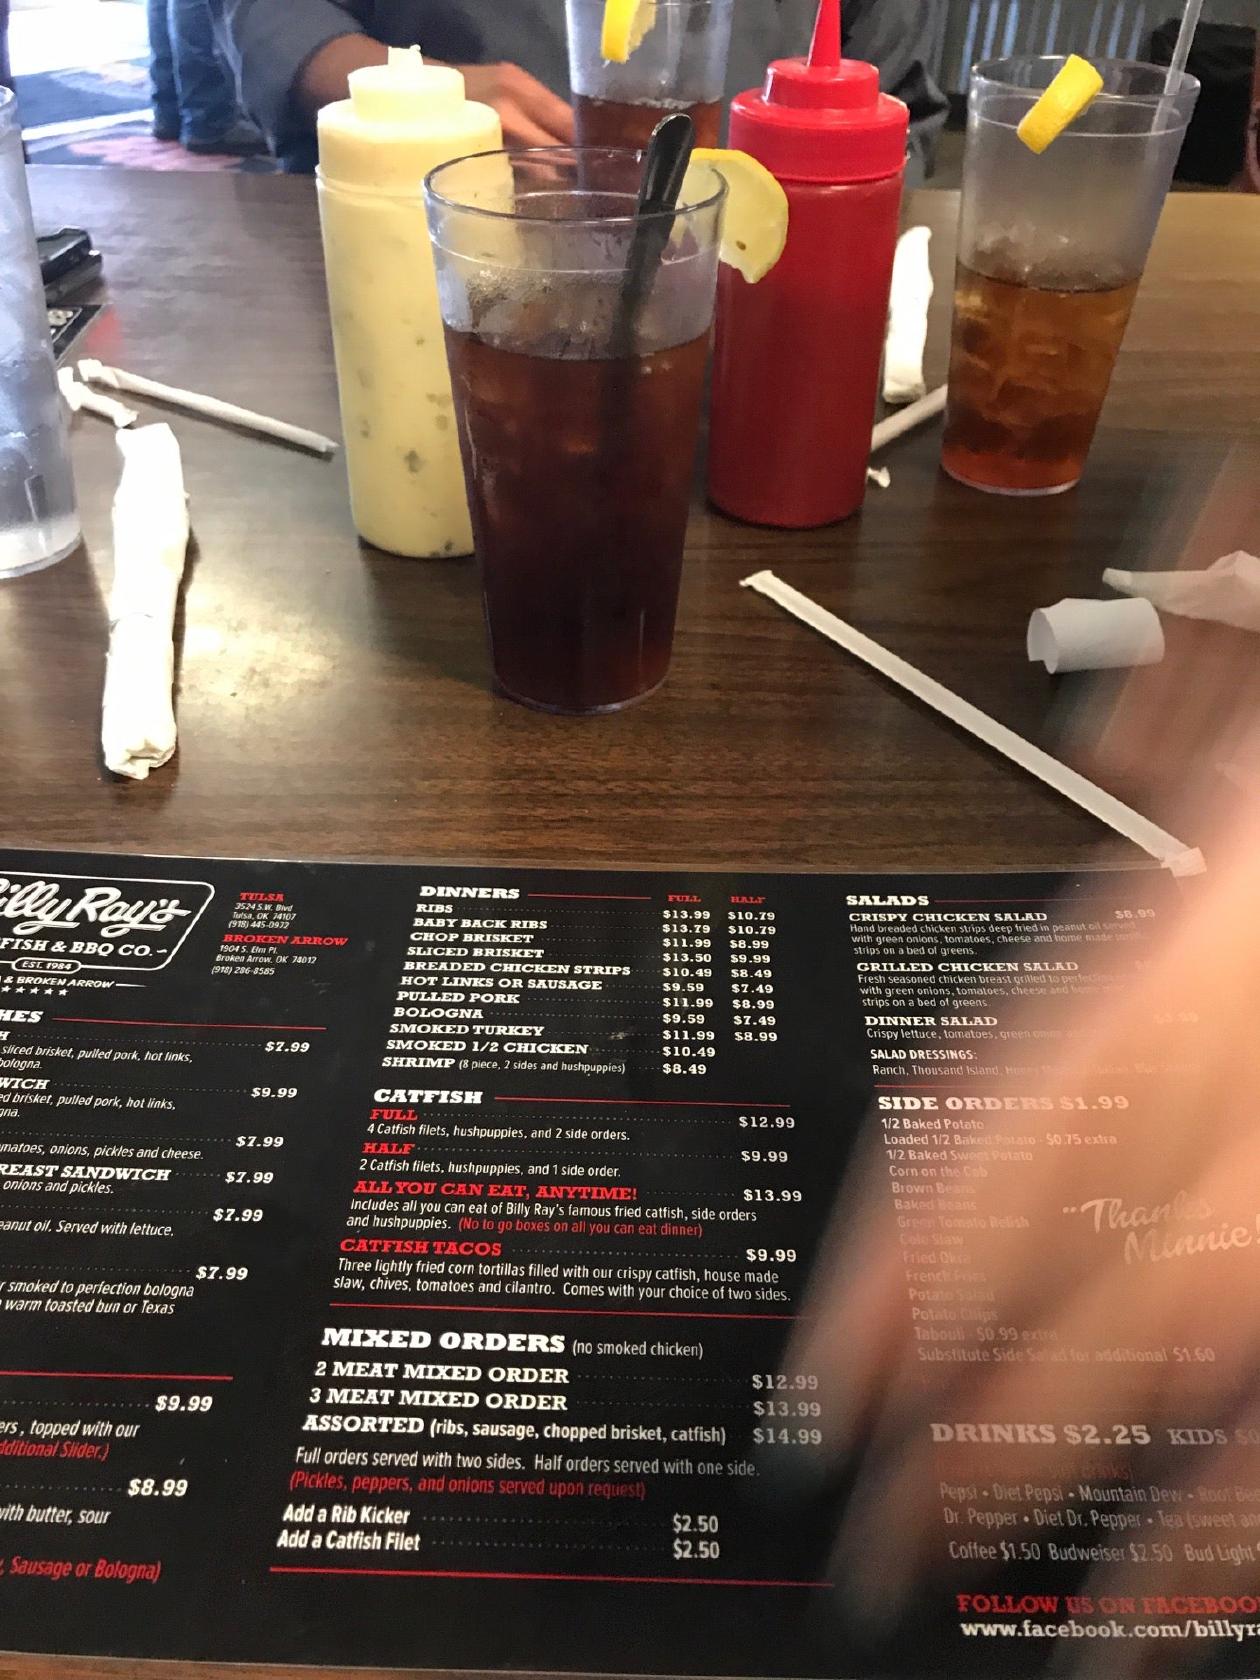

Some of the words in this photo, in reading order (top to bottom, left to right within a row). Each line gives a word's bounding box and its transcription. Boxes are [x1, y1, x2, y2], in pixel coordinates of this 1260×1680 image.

[239, 892, 283, 901] TULSA
[419, 885, 520, 899] DINNERS
[846, 895, 929, 906] SALADS
[65, 886, 191, 938] Ray's
[234, 902, 256, 911] 3524
[256, 903, 273, 911] S.W.
[275, 903, 294, 912] Blvd
[415, 903, 453, 913] RIBS
[663, 909, 710, 919] $13.99
[727, 911, 775, 920] $10.79
[849, 913, 907, 921] CRISPY
[912, 913, 990, 921] CHICKEN
[994, 912, 1047, 921] SALAD
[412, 917, 458, 927] BABY
[460, 918, 507, 928] BACK
[509, 919, 547, 929] RIBS
[662, 923, 710, 933] $13.79
[728, 925, 776, 934] $10.79
[223, 934, 289, 944] BROKEN
[290, 936, 348, 945] ARROW
[410, 932, 459, 942] CHOP
[462, 933, 534, 943] BRISKET
[662, 938, 711, 948] $11.99
[50, 940, 67, 952] &
[68, 941, 114, 957] BBQ
[118, 944, 153, 956] CO.
[729, 939, 769, 949] $8.99
[406, 946, 468, 956] SLICED
[472, 947, 544, 958] BRISKET
[663, 952, 711, 962] $13.50
[730, 954, 770, 963] $9.99
[22, 961, 43, 970] EST.
[45, 962, 73, 971] 1984
[403, 961, 486, 971] BREADED
[489, 962, 570, 974] CHICKEN
[573, 965, 630, 975] STRIPS
[662, 967, 712, 977] $10.49
[856, 962, 933, 972] GRILLED
[937, 962, 1018, 972] CHICKEN
[1023, 961, 1079, 971] SALAD
[731, 968, 772, 978] $8.49
[3, 975, 14, 983] &
[16, 976, 67, 986] BROKEN
[66, 978, 115, 988] ARROW
[400, 976, 438, 986] HOT
[441, 976, 494, 987] LINKS
[497, 978, 523, 988] OR
[527, 978, 602, 990] SAUSAGE
[663, 982, 704, 992] $9.59
[731, 983, 773, 993] $7.49
[396, 990, 465, 1002] PULLED
[468, 992, 520, 1004] PORK
[662, 997, 713, 1008] $11.99
[732, 999, 774, 1009] $8.99
[393, 1006, 484, 1019] BOLOGNA
[662, 1013, 704, 1024] $9.59
[733, 1015, 776, 1026] $7.49
[864, 1016, 936, 1026] DINNER
[940, 1016, 998, 1026] SALAD
[389, 1023, 469, 1034] SMOKED
[472, 1024, 545, 1036] TURKEY
[662, 1029, 714, 1040] $11.99
[734, 1031, 777, 1041] $8.99
[264, 1041, 310, 1052] $7.99
[386, 1039, 466, 1051] SMOKED
[471, 1041, 499, 1052] 1/2
[503, 1042, 589, 1054] CHICKEN
[662, 1046, 715, 1057] $10.49
[1, 1044, 34, 1055] sliced
[34, 1045, 74, 1059] brisket,
[76, 1048, 113, 1060] pulled
[112, 1050, 140, 1061] pork,
[144, 1050, 163, 1061] hot
[164, 1051, 192, 1063] links,
[870, 1049, 906, 1059] SALAD
[908, 1049, 978, 1060] DRESSINGS:
[381, 1056, 455, 1068] SHRIMP
[662, 1063, 706, 1074] $8.49
[250, 1087, 297, 1098] $9.99
[373, 1088, 483, 1104] CATFISH
[878, 1096, 939, 1110] SIDE
[945, 1096, 1054, 1110] ORDERS
[1059, 1095, 1129, 1110] $1.99
[369, 1108, 417, 1121] FULL
[739, 1116, 795, 1128] $12.99
[367, 1123, 375, 1133] 4
[377, 1123, 416, 1135] Catfish
[418, 1123, 449, 1137] filets,
[453, 1125, 527, 1139] hushpuppies,
[530, 1128, 552, 1138] and
[555, 1127, 562, 1139] 2
[565, 1128, 588, 1139] side
[590, 1129, 630, 1140] orders.
[235, 1135, 284, 1147] $7.99
[362, 1142, 415, 1154] HALF
[741, 1150, 787, 1162] $9.99
[60, 1165, 172, 1181] SANDWICH
[224, 1171, 274, 1184] $7.99
[353, 1180, 392, 1194] ALL
[395, 1181, 437, 1194] YOU
[440, 1182, 484, 1196] CAN
[487, 1184, 529, 1200] EAT,
[535, 1185, 636, 1200] ANYTIME!
[743, 1188, 802, 1202] $13.99
[212, 1208, 263, 1222] $7.99
[340, 1238, 429, 1254] CATFISH
[432, 1241, 501, 1256] TACOS
[746, 1248, 796, 1262] $9.99
[195, 1265, 248, 1280] $7.99
[321, 1327, 432, 1348] MIXED
[439, 1331, 565, 1353] ORDERS
[572, 1339, 593, 1356] (no
[596, 1340, 647, 1355] smoked
[650, 1341, 703, 1360] chicken)
[314, 1361, 327, 1376] 2
[331, 1361, 399, 1378] MEAT
[402, 1363, 482, 1381] MIXED
[488, 1366, 569, 1383] ORDER
[752, 1374, 818, 1390] $12.99
[155, 1395, 213, 1412] $9.99
[309, 1387, 321, 1403] 3
[325, 1388, 395, 1405] MEAT
[398, 1389, 479, 1408] MIXED
[485, 1392, 568, 1410] ORDER
[753, 1401, 821, 1417] $13.99
[301, 1414, 424, 1433] ASSORTED
[430, 1418, 468, 1438] (ribs,
[472, 1423, 539, 1441] sausage,
[543, 1423, 607, 1442] chopped
[611, 1424, 667, 1443] brisket,
[671, 1426, 726, 1446] catfish)
[753, 1427, 822, 1445] $14.99
[930, 1423, 1057, 1444] DRINKS
[1063, 1424, 1151, 1446] $2.25
[1167, 1428, 1229, 1446] KIDS
[127, 1478, 188, 1496] $8.99
[282, 1503, 315, 1522] Add
[317, 1508, 327, 1523] a
[331, 1504, 357, 1523] Rib
[359, 1505, 410, 1524] Kicker
[673, 1513, 718, 1533] $2.50
[9, 1555, 73, 1580] Sausage
[74, 1562, 92, 1577] or
[94, 1558, 161, 1584] Bologna)
[955, 1594, 1059, 1613] FOLLOW
[1066, 1595, 1094, 1614] US
[1143, 1596, 1260, 1614] FACEBOO
